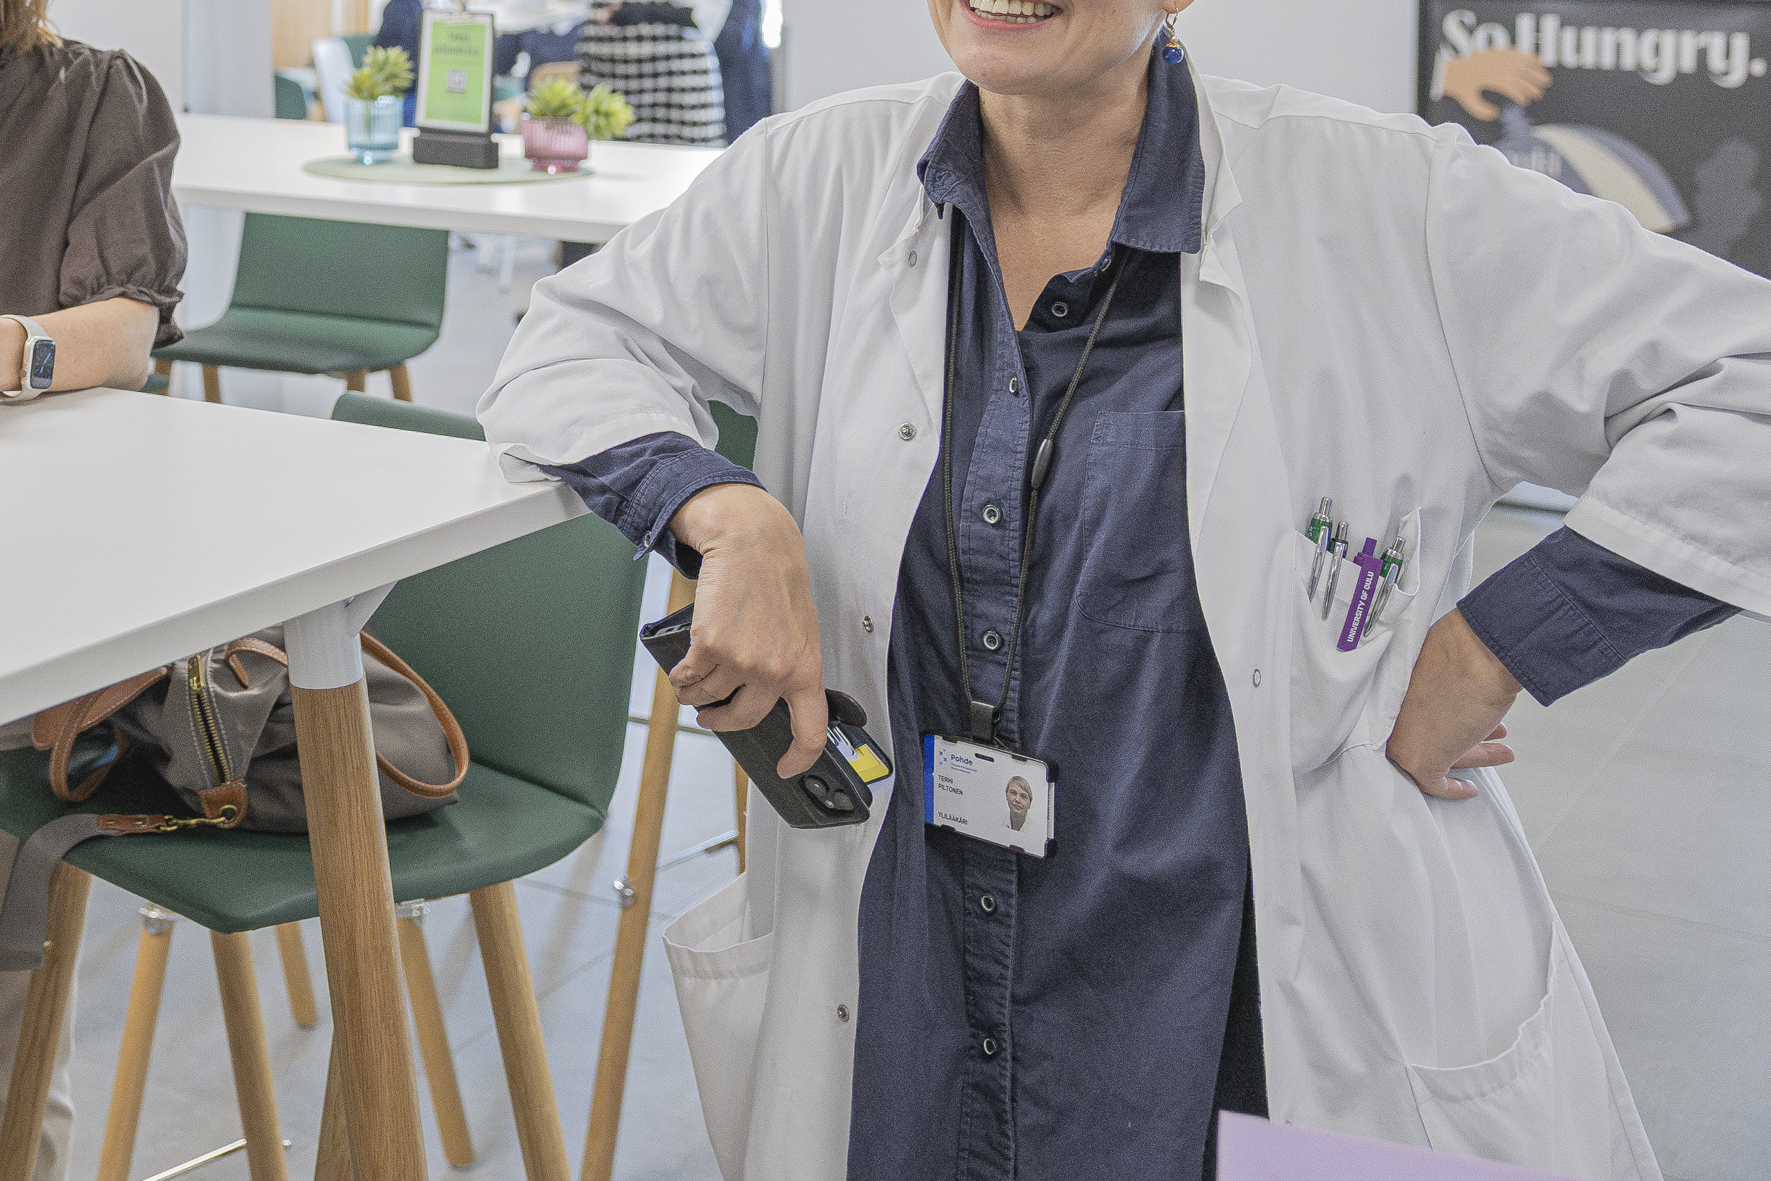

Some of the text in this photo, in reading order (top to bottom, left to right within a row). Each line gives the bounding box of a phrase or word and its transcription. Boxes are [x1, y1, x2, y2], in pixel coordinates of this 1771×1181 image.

[1347, 571, 1374, 643] UNIVERSITY OF OULU
[950, 754, 973, 766] Pohde
